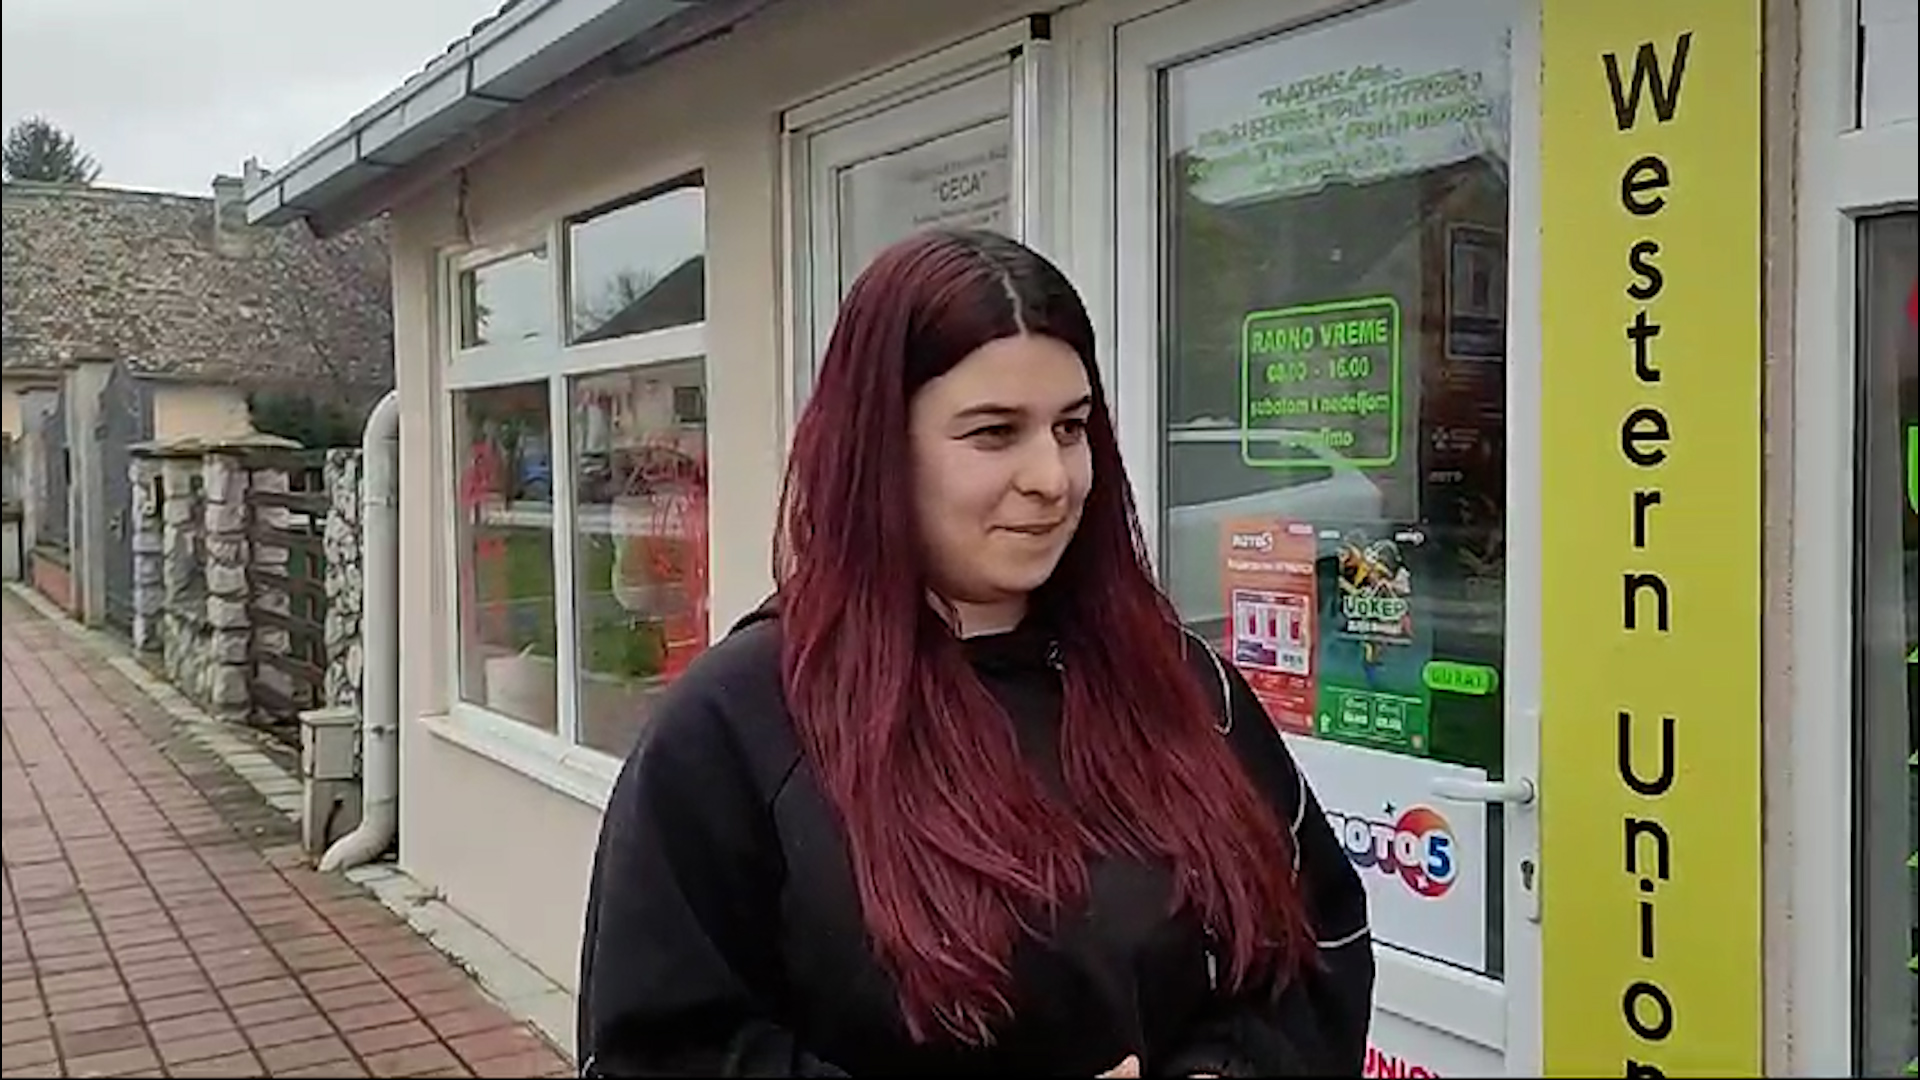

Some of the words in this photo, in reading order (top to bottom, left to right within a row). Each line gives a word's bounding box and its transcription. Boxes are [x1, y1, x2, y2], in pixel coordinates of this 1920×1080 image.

[1252, 326, 1314, 353] RADNO
[1320, 318, 1388, 347] VREME
[1602, 32, 1692, 631] Western
[1329, 355, 1370, 379] 16.00
